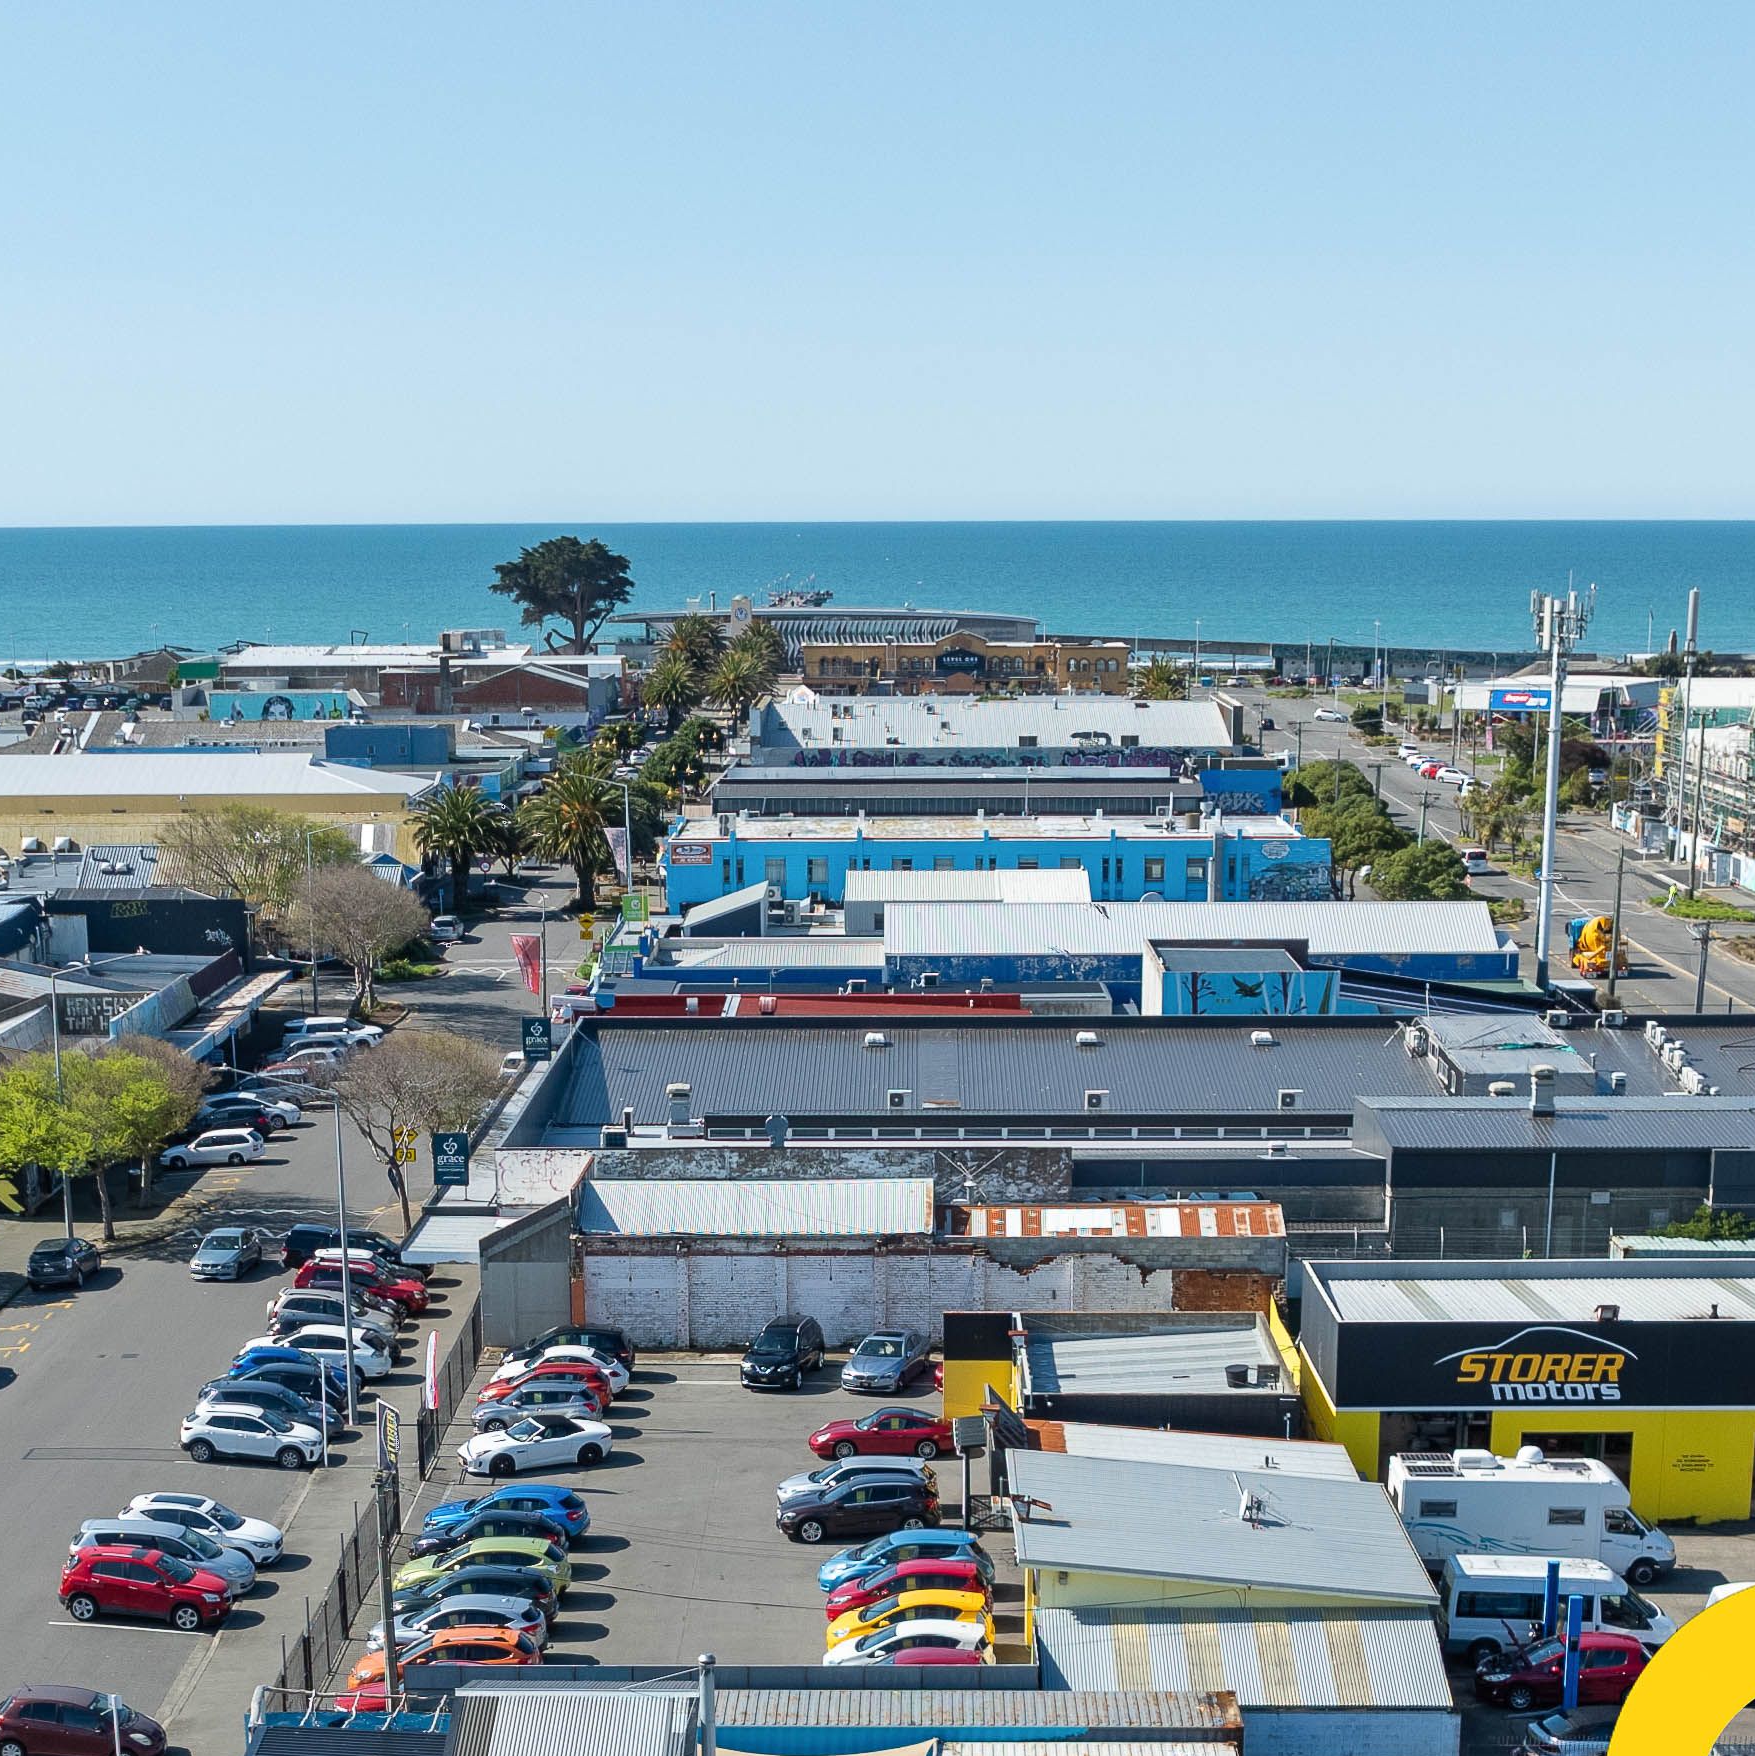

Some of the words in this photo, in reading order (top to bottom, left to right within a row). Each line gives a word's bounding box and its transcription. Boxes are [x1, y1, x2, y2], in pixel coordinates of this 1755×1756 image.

[437, 1154, 465, 1166] grace
[1457, 1353, 1625, 1382] STORER
[1491, 1379, 1621, 1401] motors
